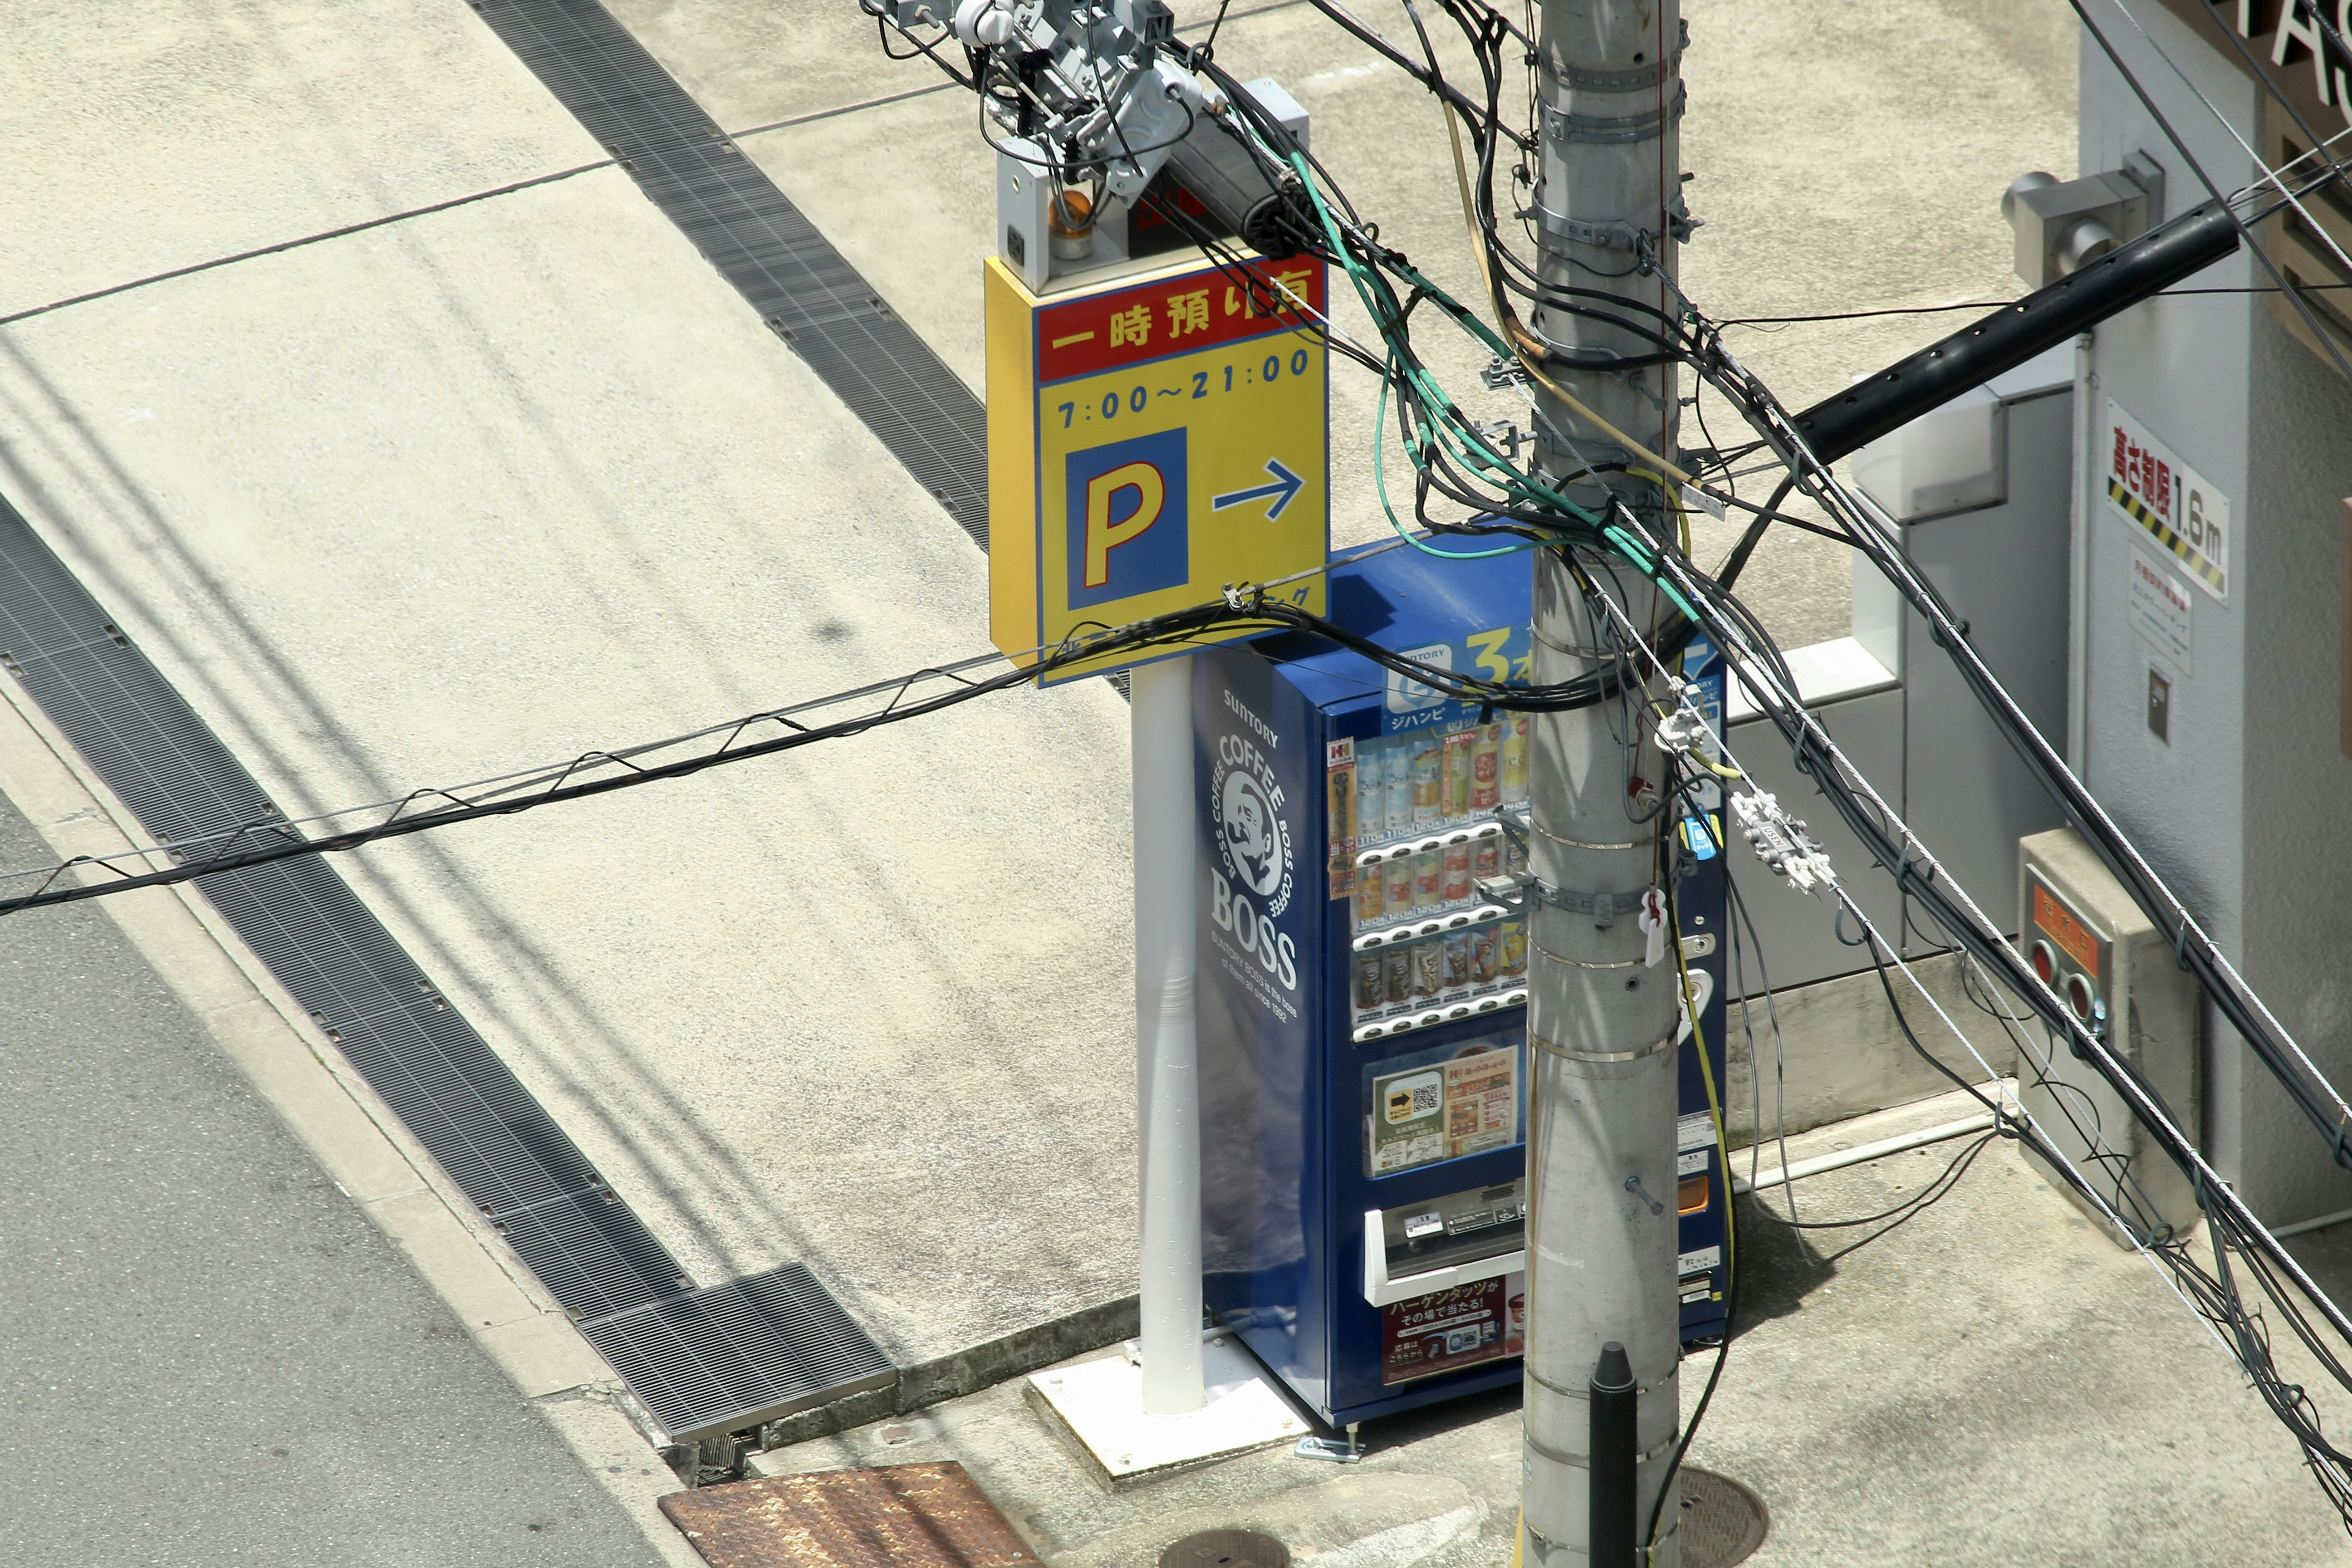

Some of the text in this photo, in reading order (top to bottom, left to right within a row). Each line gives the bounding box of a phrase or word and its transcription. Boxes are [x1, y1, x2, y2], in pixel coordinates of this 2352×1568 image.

[1083, 460, 1166, 589] P
[1224, 689, 1279, 750] SUNTORY
[1220, 734, 1285, 812] COFFEE
[1212, 760, 1237, 880] BOSS COFFEE
[1268, 819, 1294, 918] BOSS COFFEE
[1211, 867, 1297, 991] BOSS
[1211, 931, 1297, 1018] SUNTORY BOSS is the boss
[1221, 958, 1287, 1024] of them all since 1992
